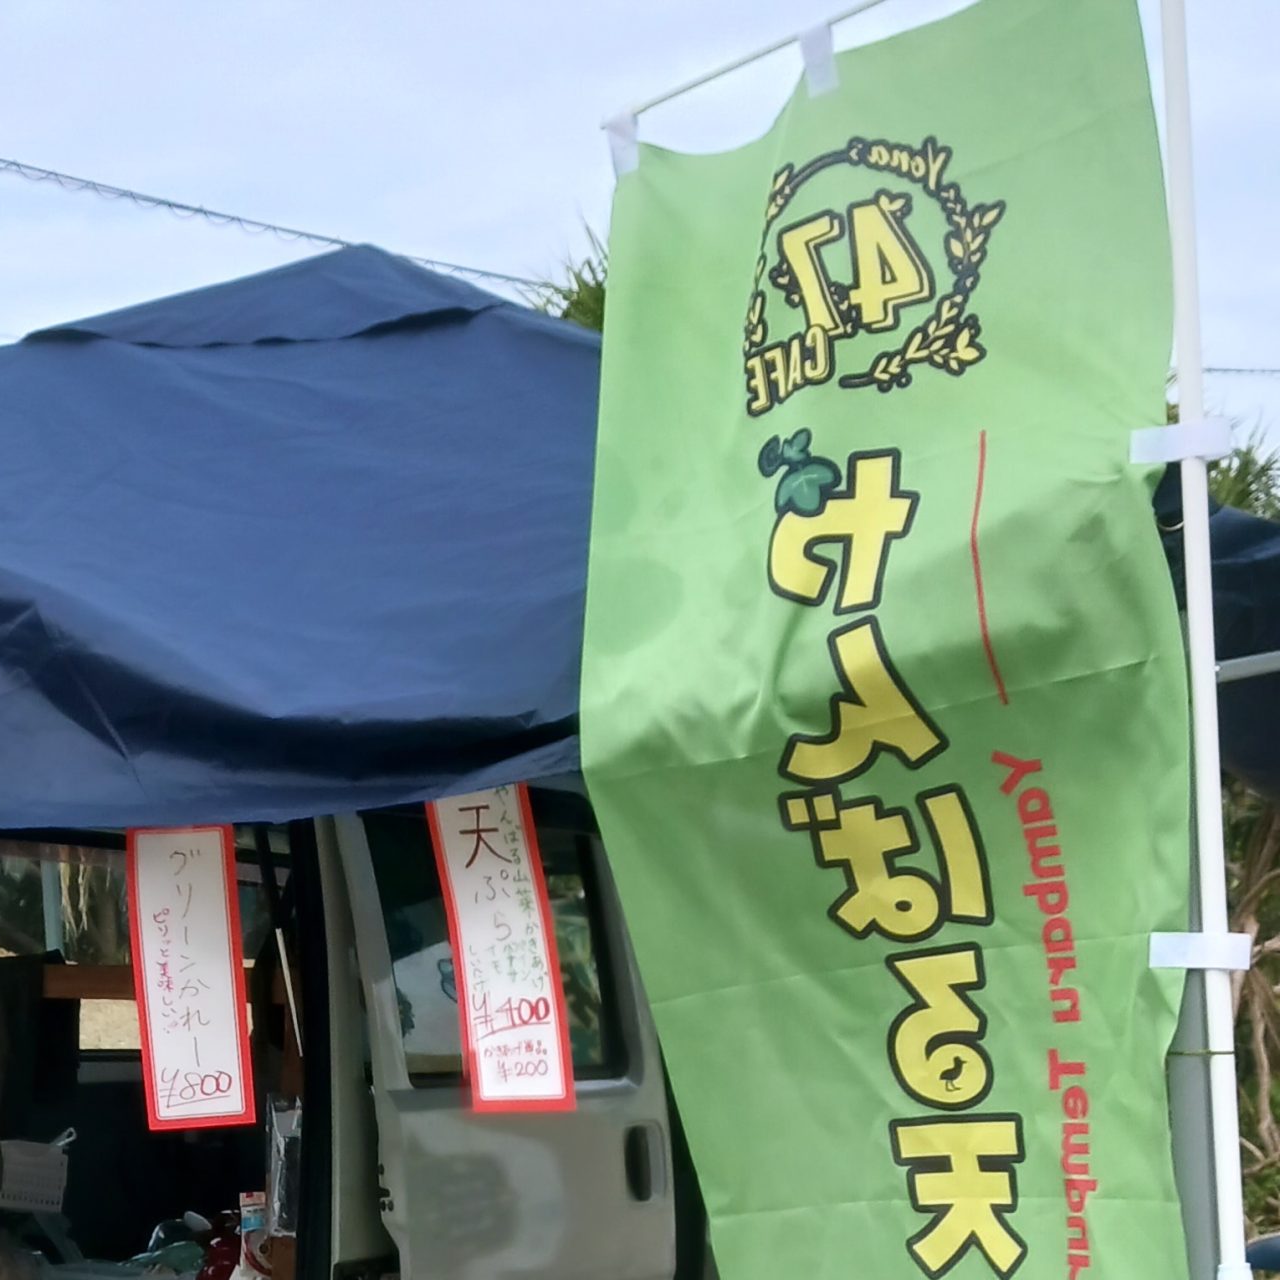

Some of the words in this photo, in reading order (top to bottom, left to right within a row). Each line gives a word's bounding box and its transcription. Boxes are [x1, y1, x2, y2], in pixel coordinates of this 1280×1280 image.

[458, 803, 514, 944] 天ぷら
[169, 848, 212, 1068] グリーンかれー
[471, 990, 551, 1034] ¥400
[160, 1066, 234, 1109] ¥800
[496, 1058, 549, 1083] ¥200
